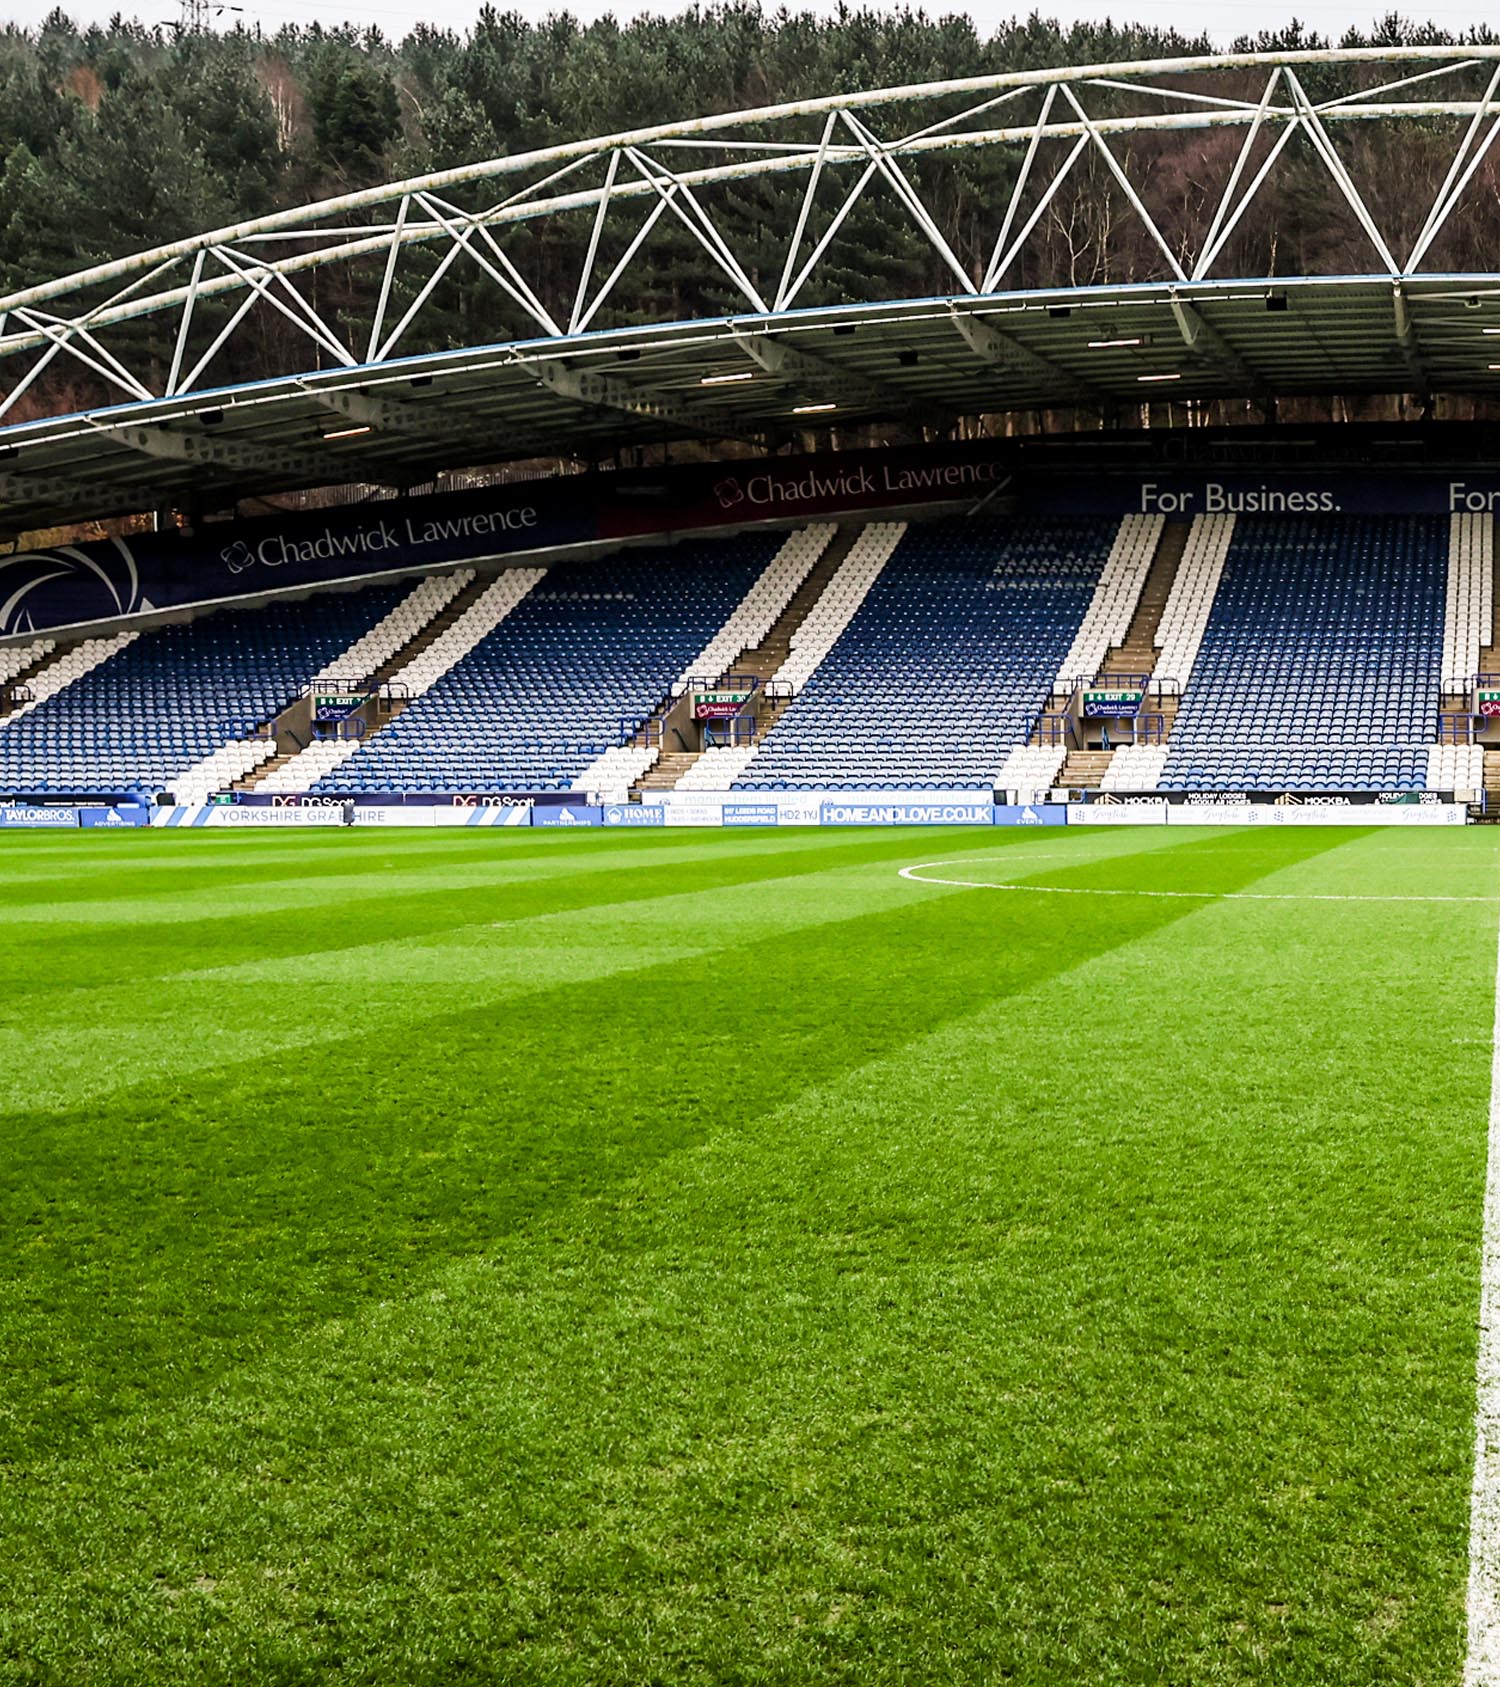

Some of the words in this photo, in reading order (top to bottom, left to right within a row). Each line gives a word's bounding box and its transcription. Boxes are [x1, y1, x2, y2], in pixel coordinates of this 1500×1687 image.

[747, 467, 875, 503] Chadwick
[1141, 484, 1193, 512] For
[1205, 484, 1342, 512] Business.
[258, 520, 400, 567] Chadwick
[406, 506, 537, 544] Lawrence
[220, 810, 300, 822] YORKSHIRE
[624, 808, 663, 819] HOME
[779, 810, 800, 820] HD2
